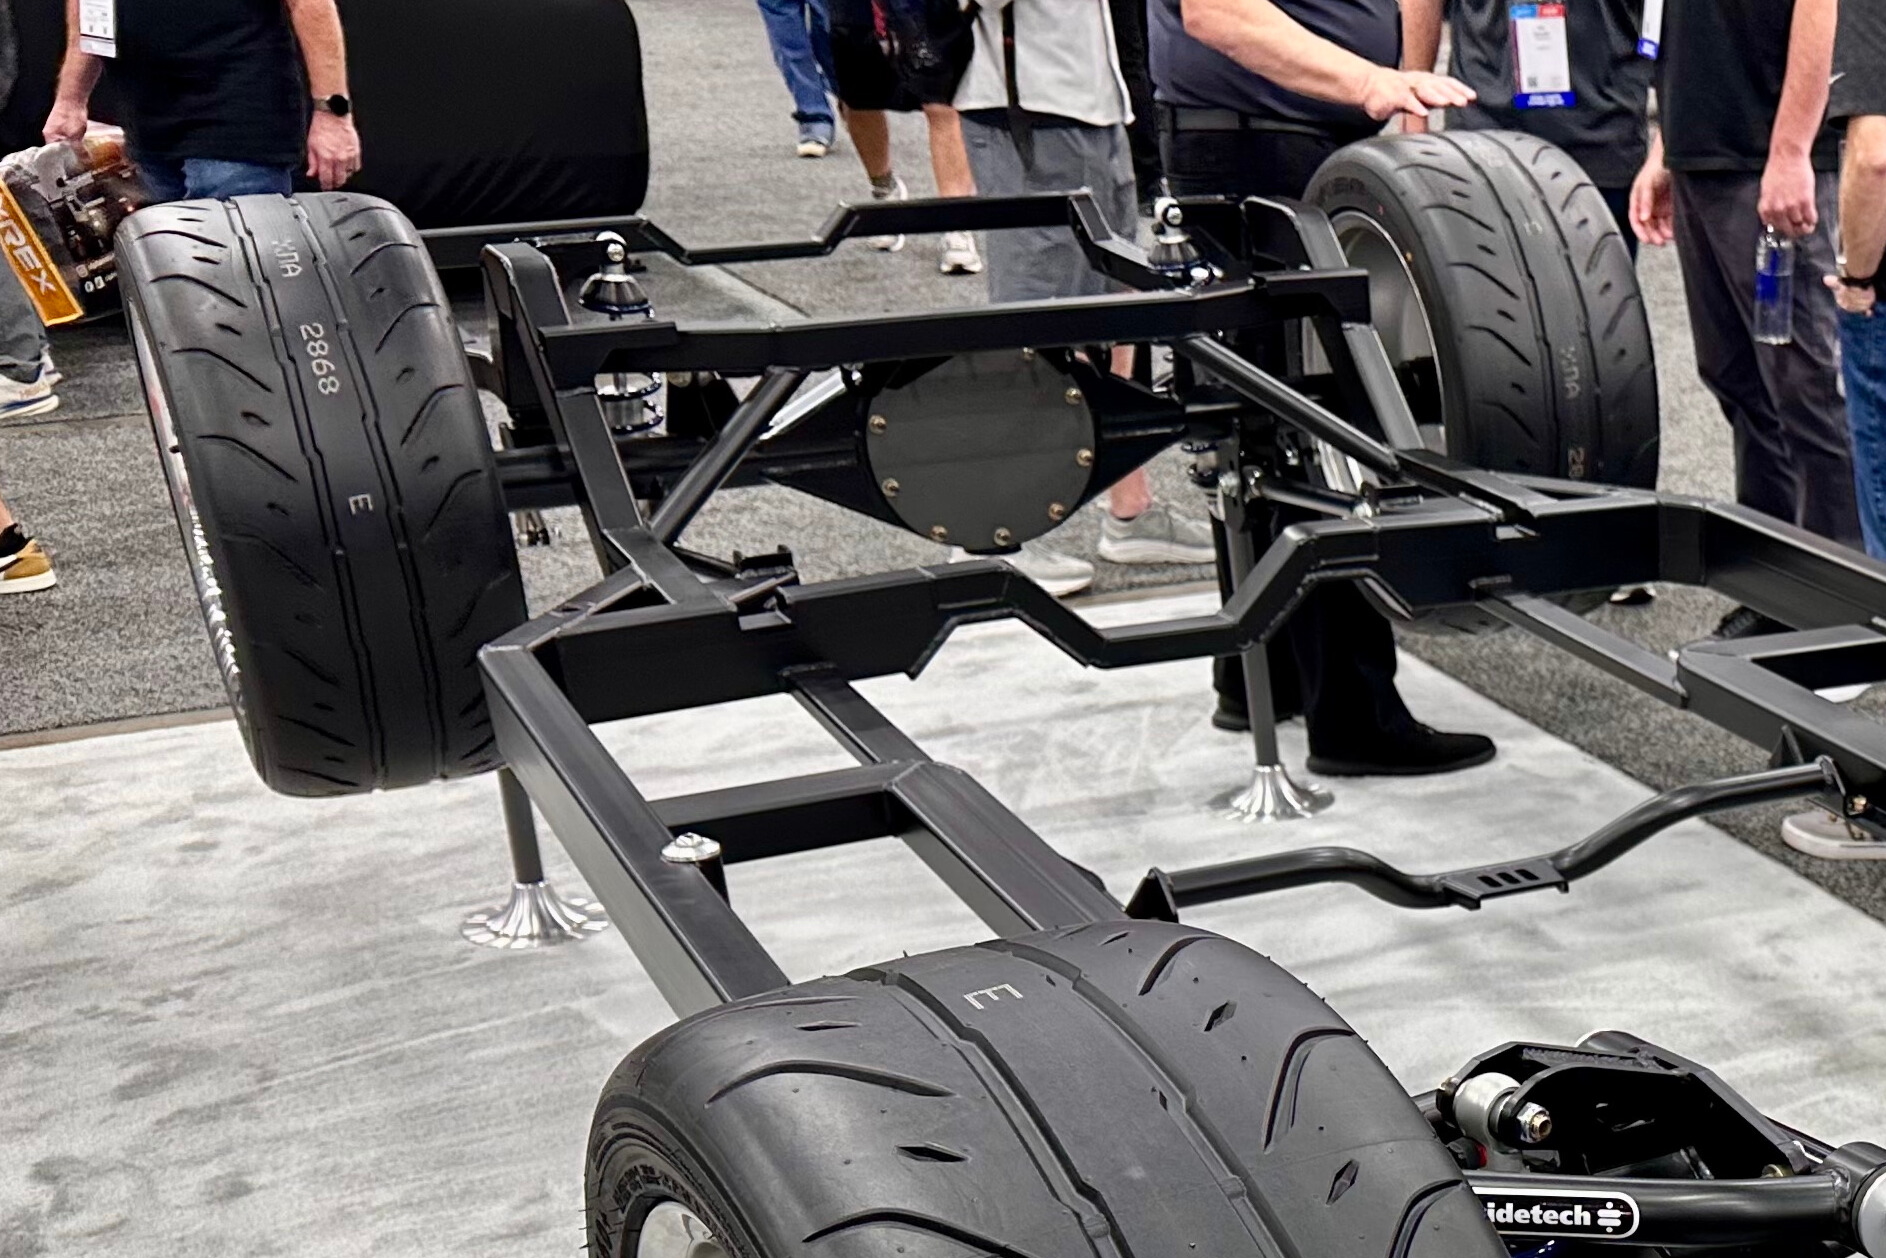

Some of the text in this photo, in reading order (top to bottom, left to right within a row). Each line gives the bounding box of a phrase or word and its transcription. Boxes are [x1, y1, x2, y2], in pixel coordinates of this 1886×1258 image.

[299, 322, 340, 395] 2868
[348, 493, 374, 516] E
[963, 983, 1024, 1010] E
[1486, 1202, 1592, 1227] idetech
